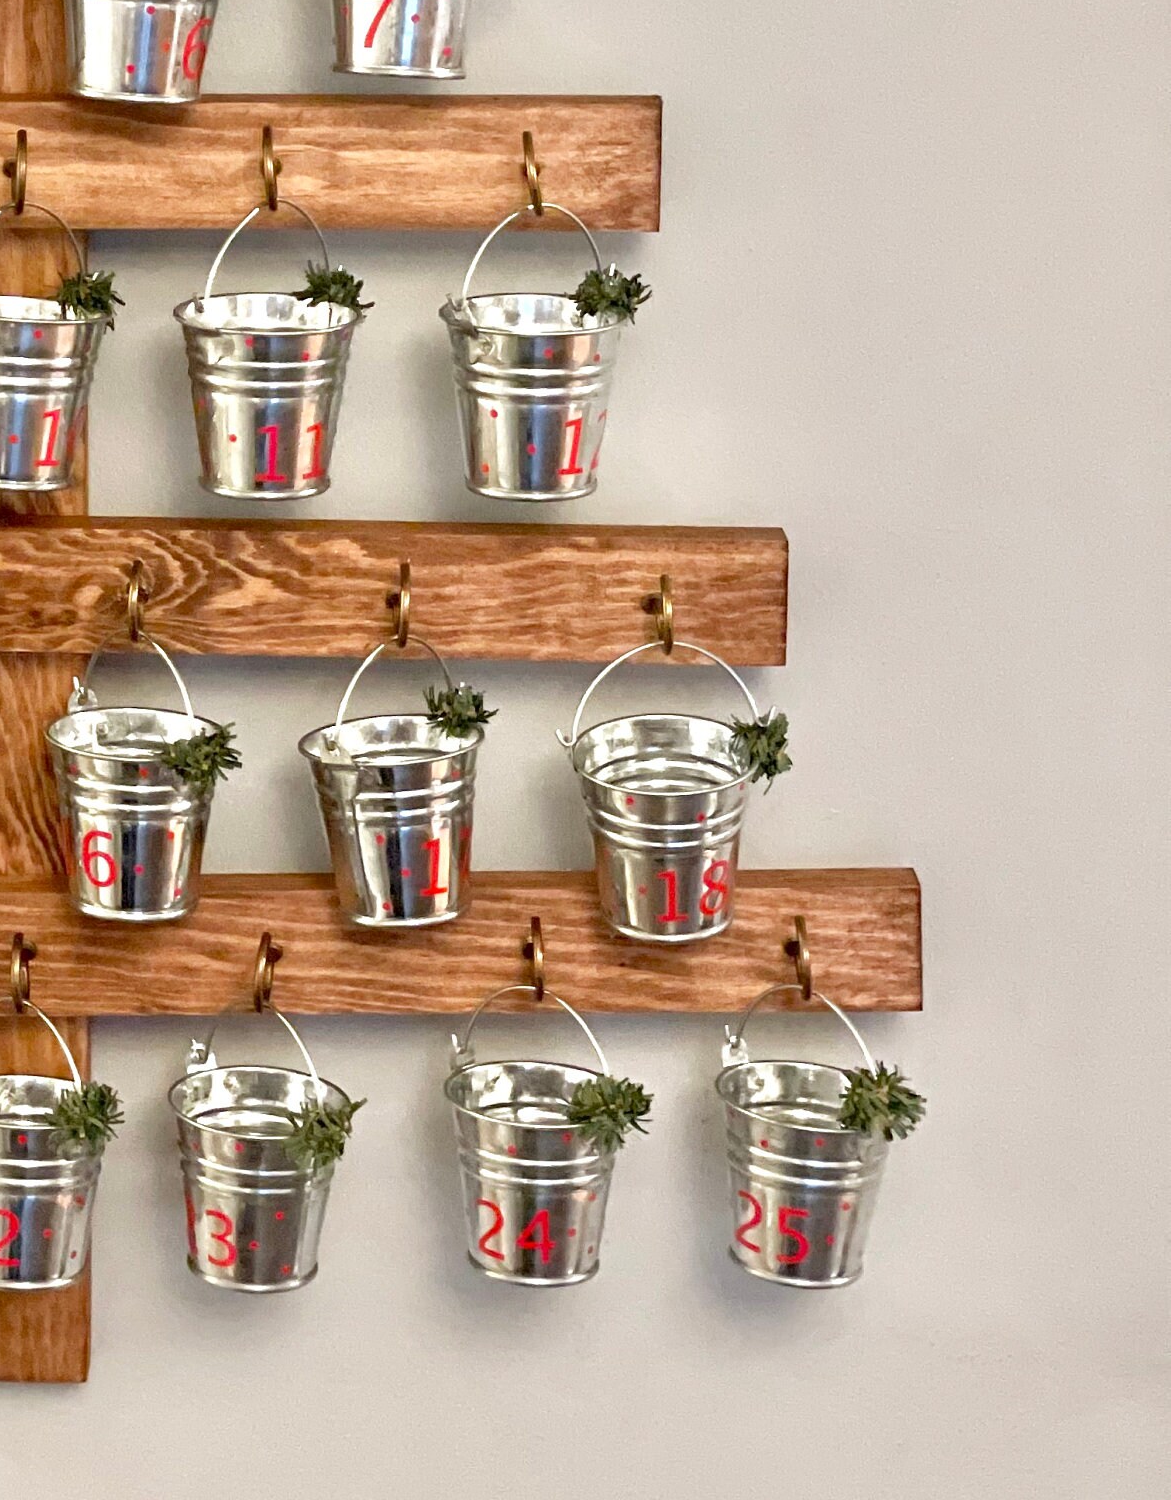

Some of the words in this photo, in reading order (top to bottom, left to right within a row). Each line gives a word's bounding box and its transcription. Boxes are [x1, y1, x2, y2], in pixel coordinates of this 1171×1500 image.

[183, 18, 210, 80] 6
[255, 422, 325, 481] 11
[656, 861, 728, 922] 18
[477, 1199, 554, 1263] 24
[733, 1190, 810, 1265] 25
